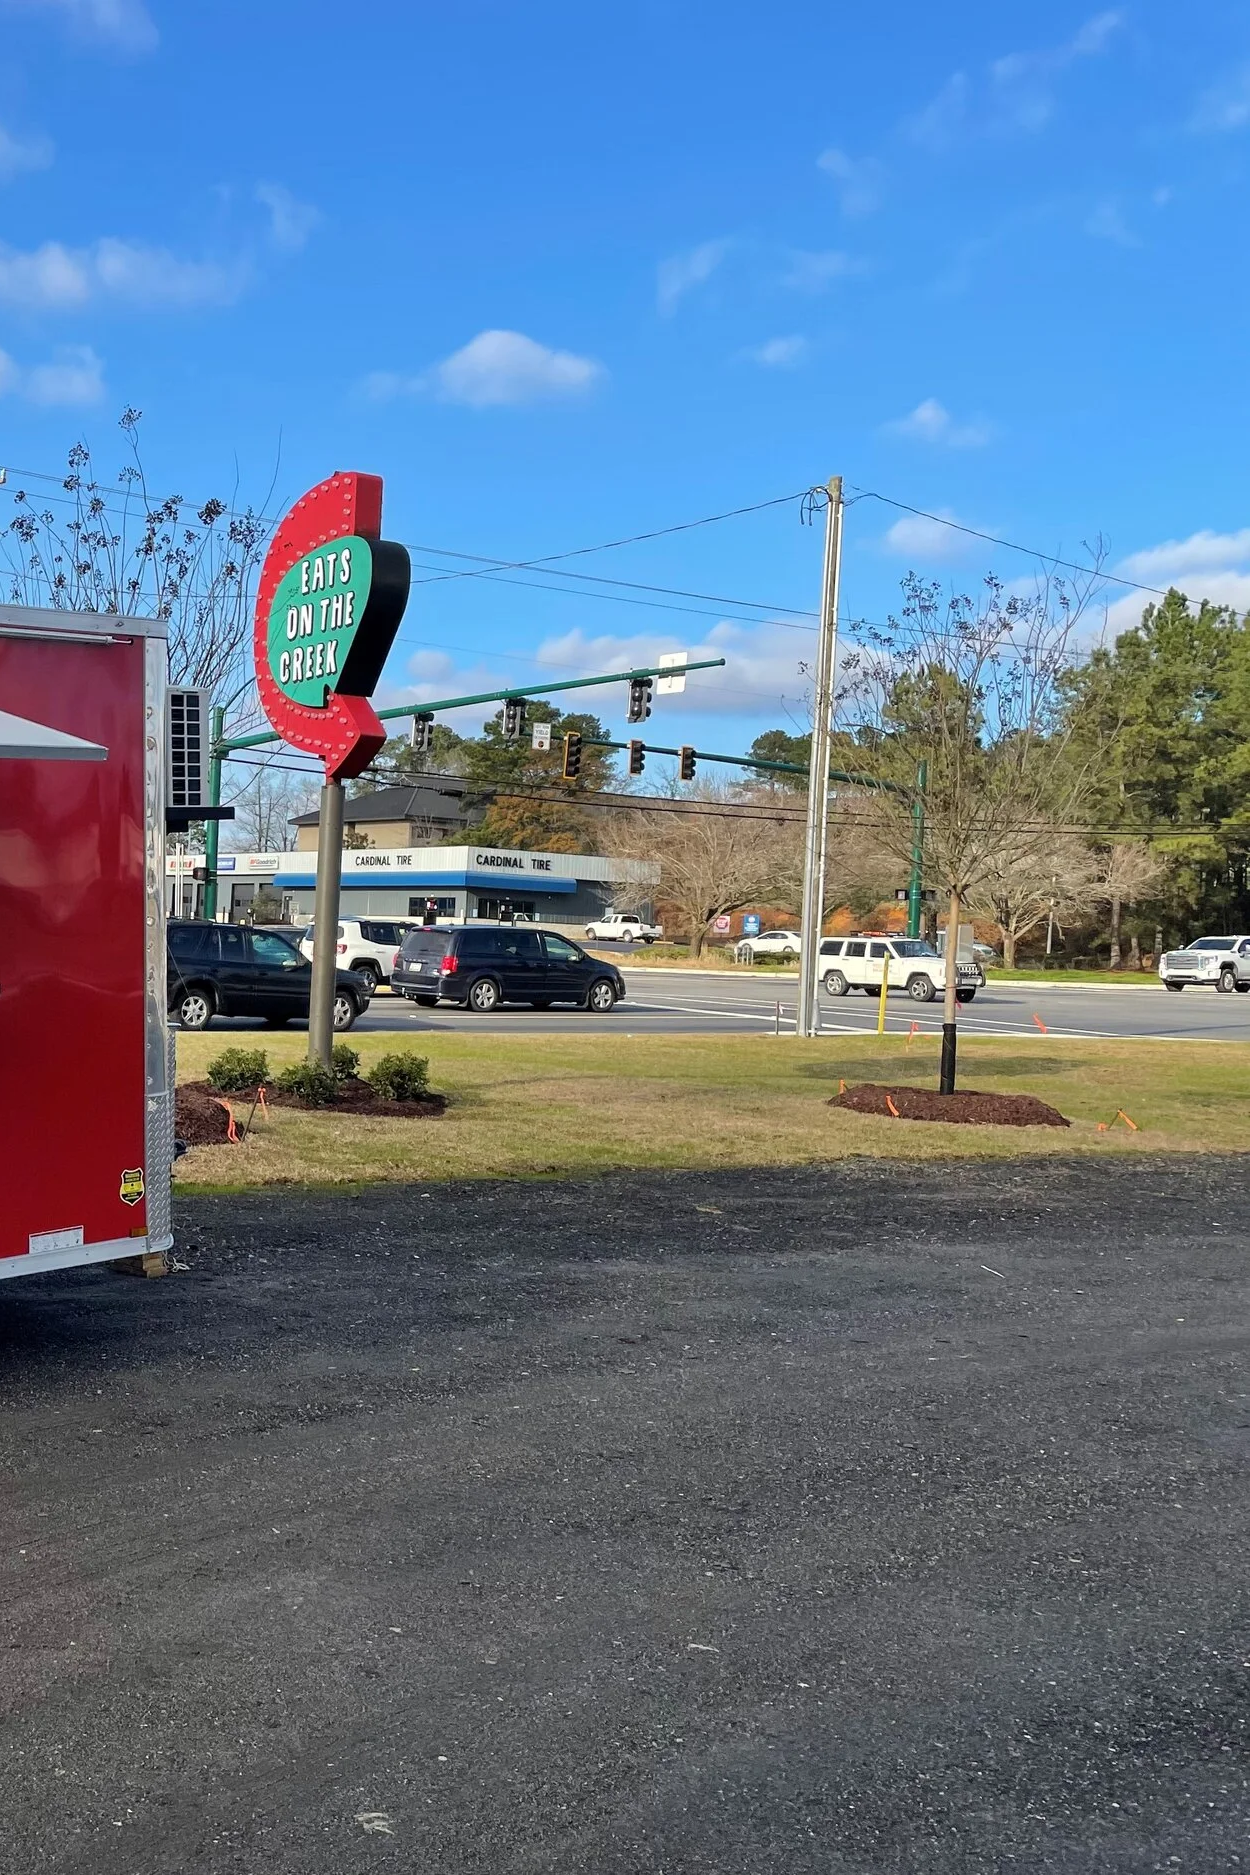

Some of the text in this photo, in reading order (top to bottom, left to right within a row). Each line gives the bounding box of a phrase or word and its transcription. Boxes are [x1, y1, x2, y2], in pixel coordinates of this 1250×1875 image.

[302, 548, 352, 595] EATS
[287, 591, 354, 640] ON THE
[279, 640, 339, 684] CREEK
[355, 855, 412, 867] CARDINAL TIRE
[476, 854, 551, 871] CARDINAL TIRE
